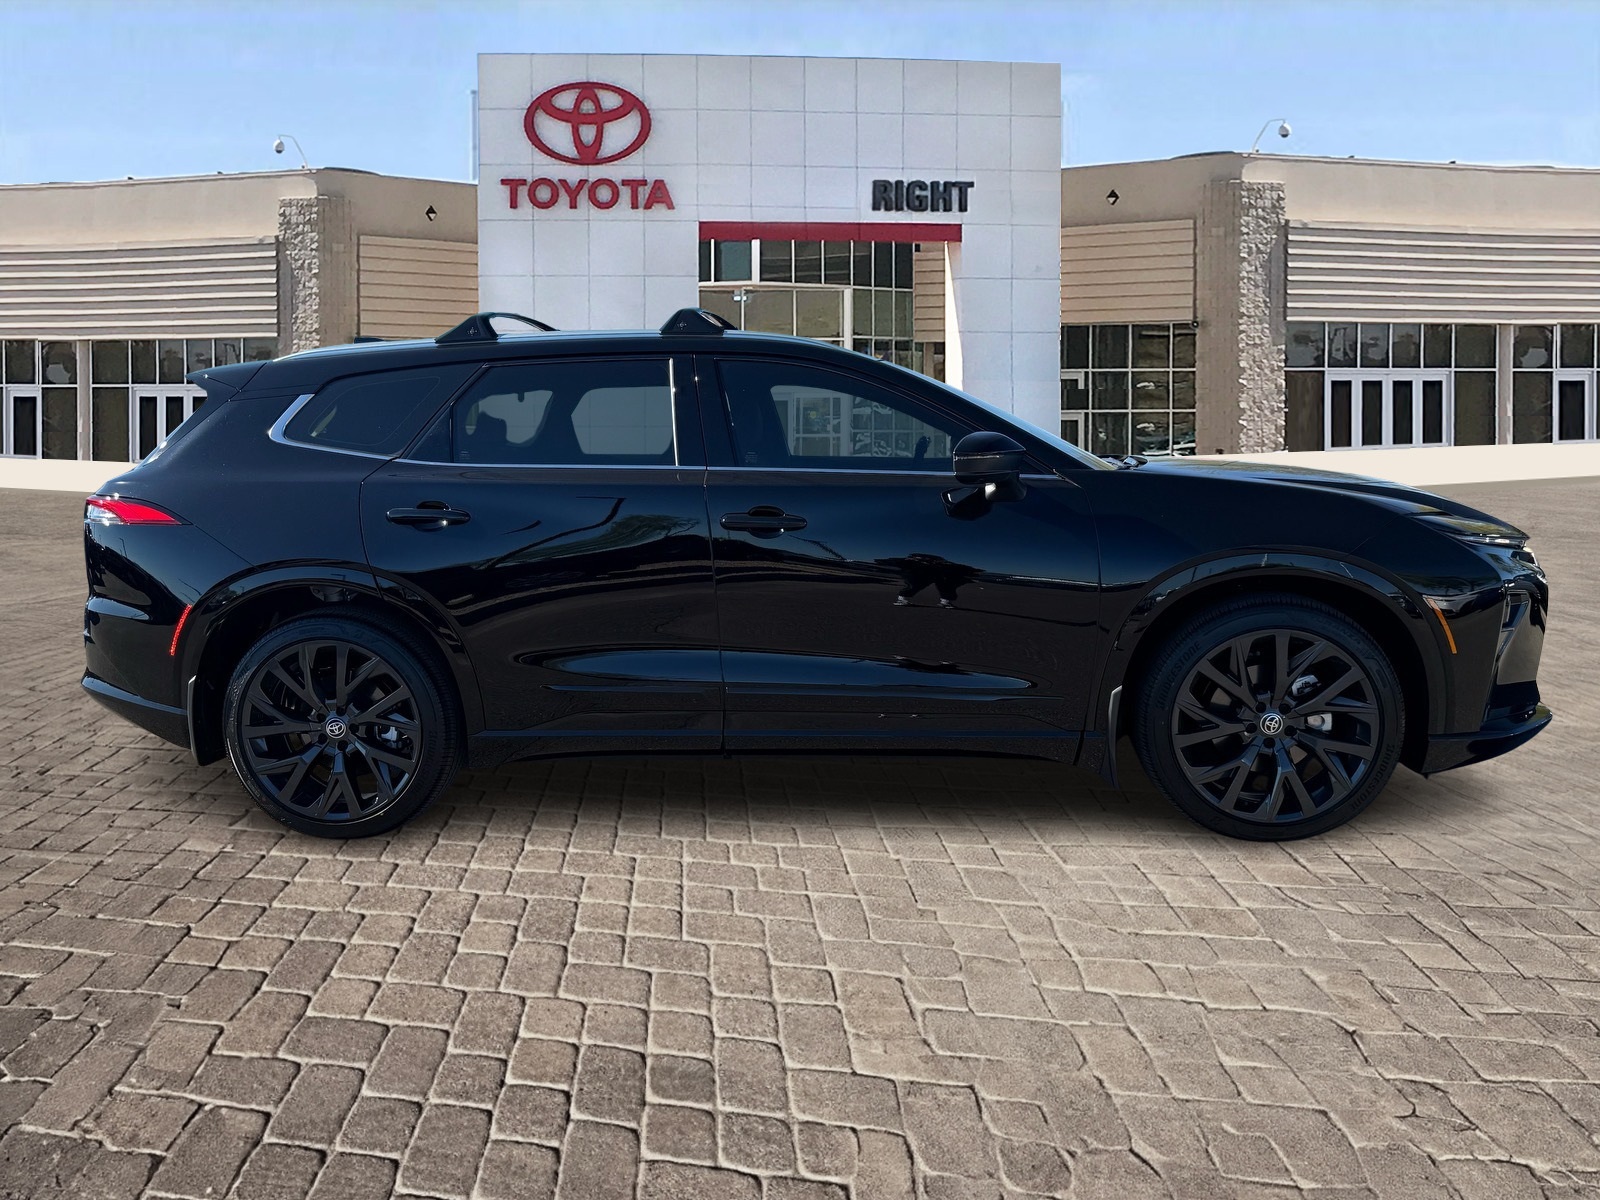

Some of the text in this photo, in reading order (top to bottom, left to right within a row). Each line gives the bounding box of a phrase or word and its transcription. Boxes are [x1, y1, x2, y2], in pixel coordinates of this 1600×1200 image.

[501, 178, 675, 210] TOYOTA
[872, 179, 975, 212] RIGHT
[1155, 640, 1202, 711] BRIDGESTONE
